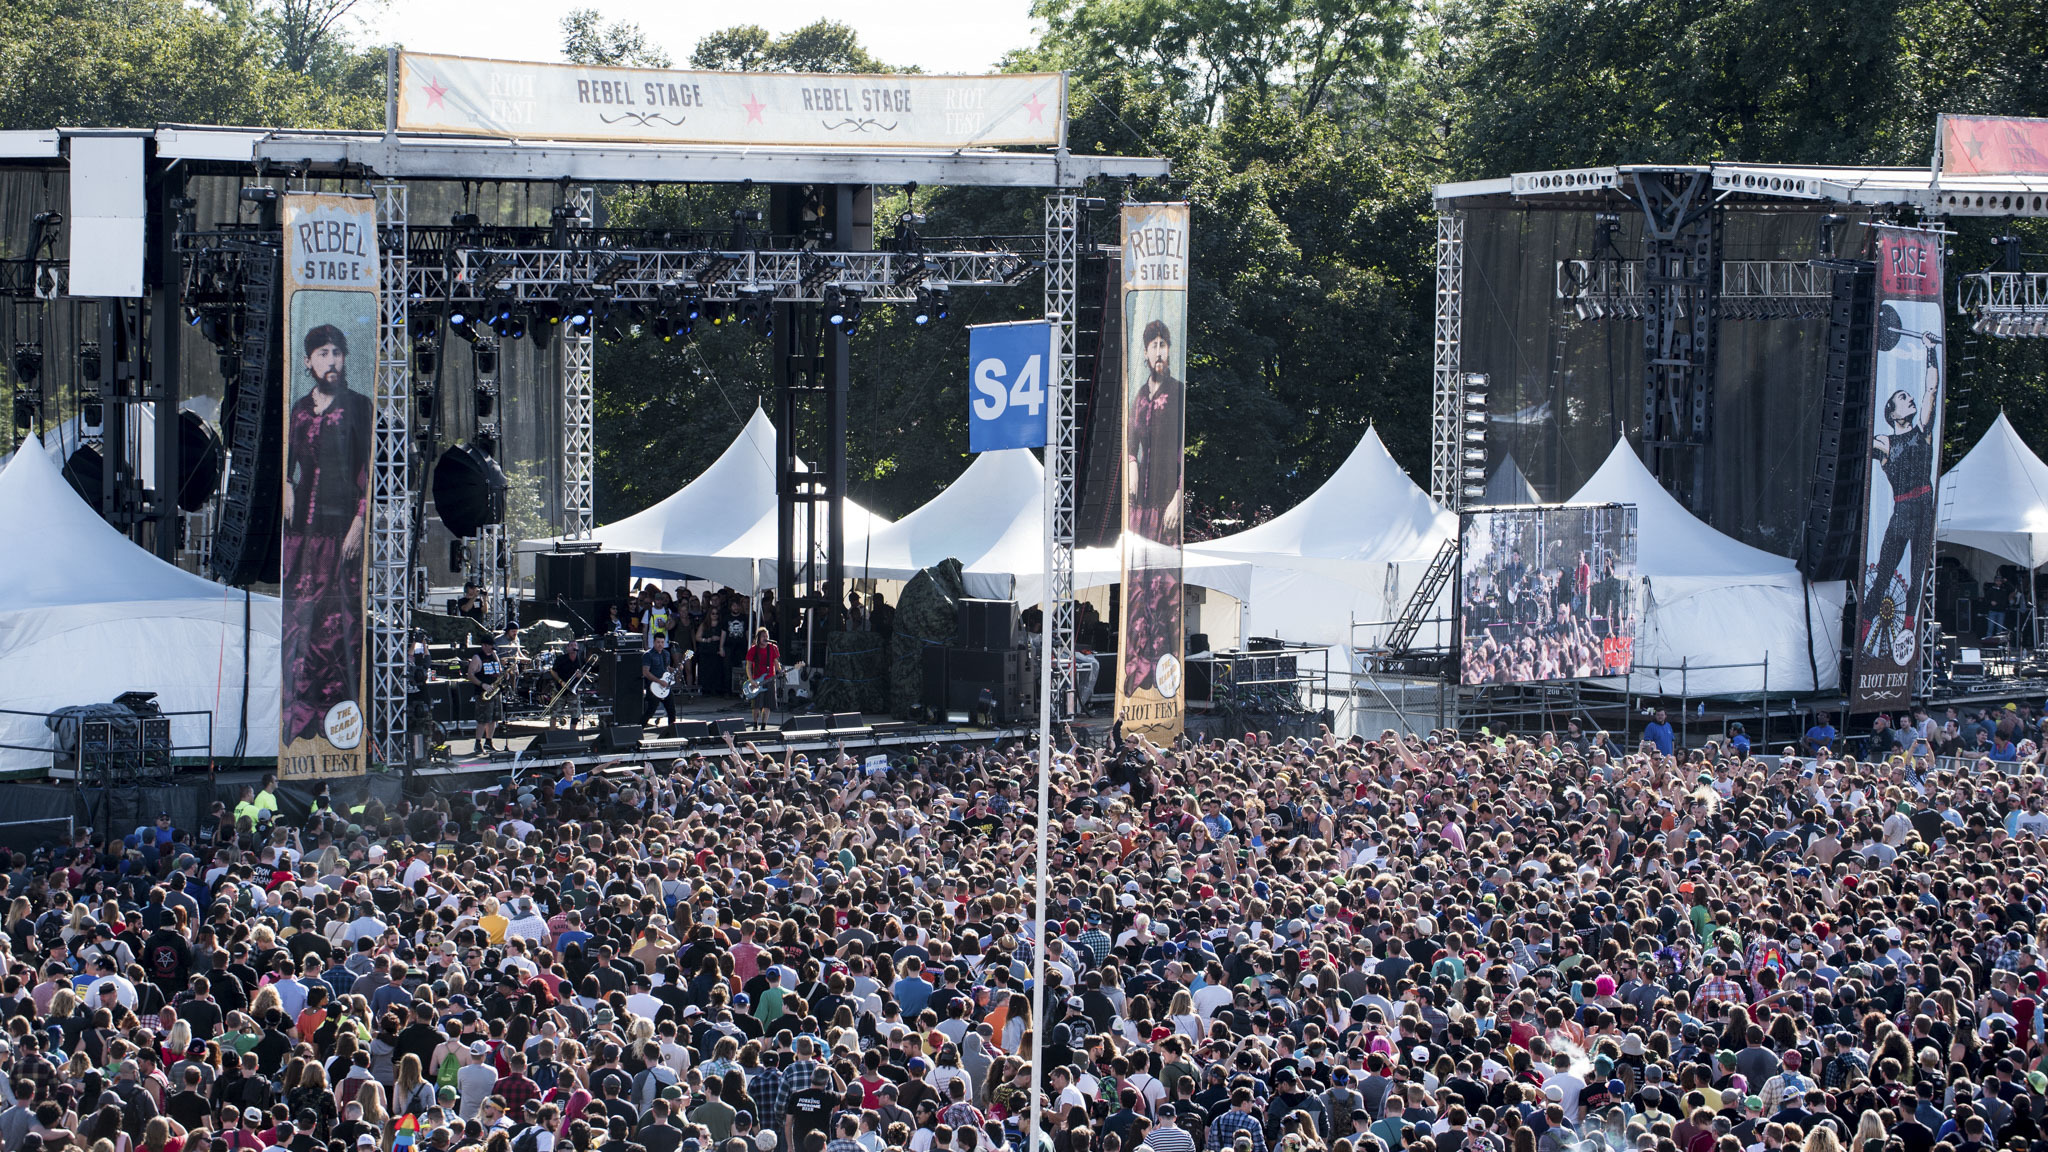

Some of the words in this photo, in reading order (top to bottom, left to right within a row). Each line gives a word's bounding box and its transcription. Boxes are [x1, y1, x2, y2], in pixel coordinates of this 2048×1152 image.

[488, 73, 537, 98] RIOT
[577, 79, 635, 105] REBEL
[644, 82, 703, 108] STAGE
[801, 87, 853, 112] REBEL
[862, 88, 911, 113] STAGE
[946, 87, 986, 110] RIOT
[489, 101, 537, 126] FEST
[945, 111, 986, 136] FEST
[299, 220, 367, 258] REBEL
[1130, 228, 1183, 260] REBEL
[305, 260, 360, 281] STAGE
[1140, 263, 1179, 281] STAGE
[1891, 246, 1927, 278] RISE
[973, 354, 1045, 421] S4
[1603, 636, 1632, 652] RIOT
[1604, 651, 1631, 669] FEST
[1859, 673, 1885, 689] RIOT
[1886, 672, 1909, 687] FEST
[337, 706, 352, 720] THE
[1122, 704, 1152, 722] RIOT
[284, 755, 317, 776] RIOT
[322, 753, 361, 773] FEST
